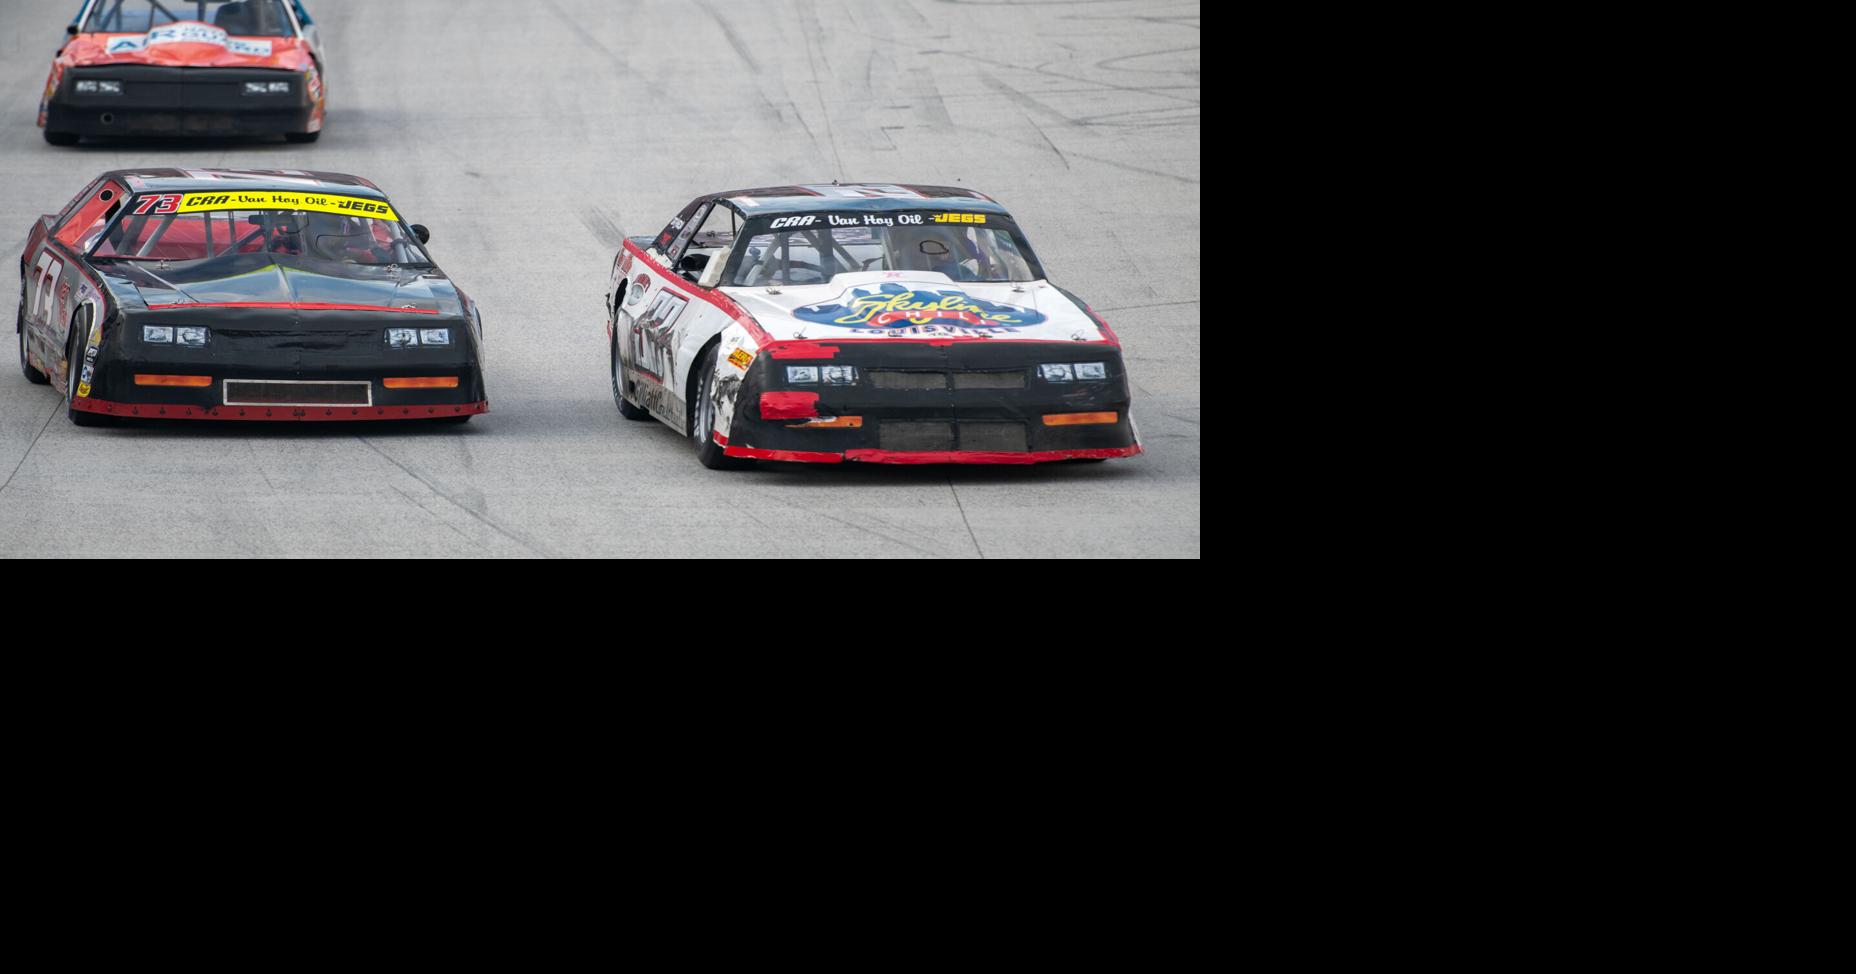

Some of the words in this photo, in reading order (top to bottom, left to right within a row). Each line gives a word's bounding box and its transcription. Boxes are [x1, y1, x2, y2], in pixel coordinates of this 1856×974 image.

[132, 193, 184, 215] 73
[272, 195, 299, 205] Hoy
[827, 214, 860, 226] Van
[863, 214, 894, 227] Hoy
[898, 214, 924, 225] Oil
[834, 292, 1022, 324] Skyline
[878, 311, 986, 325] CHILI
